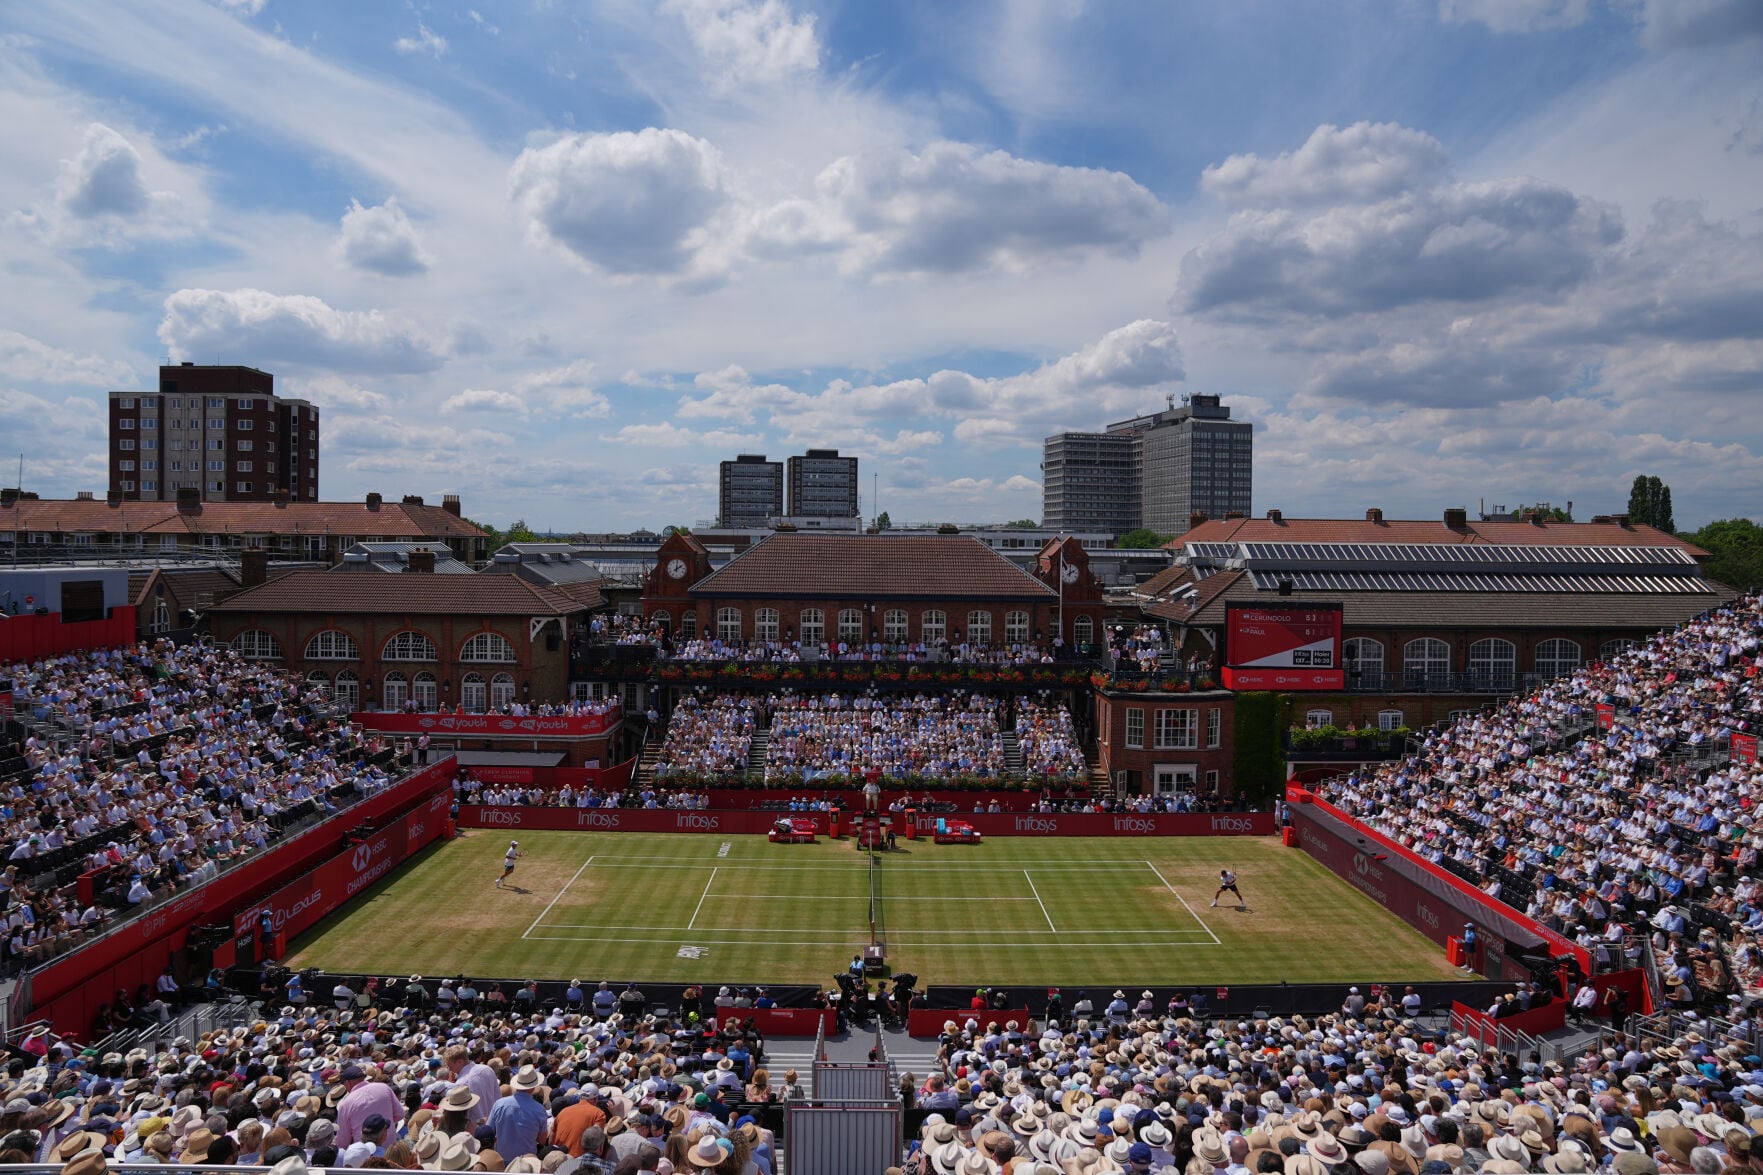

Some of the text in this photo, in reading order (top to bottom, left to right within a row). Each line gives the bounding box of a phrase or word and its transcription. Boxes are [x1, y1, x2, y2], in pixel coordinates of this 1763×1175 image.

[456, 719, 488, 731] youth
[536, 720, 568, 732] youth
[480, 808, 521, 826] Infosys
[578, 810, 620, 828] Infosys
[677, 812, 719, 830] Infosys
[1015, 816, 1057, 833] Infosys
[1114, 816, 1155, 833] Infosys
[1211, 815, 1253, 833] Infosys
[372, 837, 387, 855] HSBC
[347, 856, 392, 895] CHAMPIONSHIPS
[1349, 871, 1387, 904] CHAMPIONSHIPS
[286, 888, 321, 919] LEXUS
[153, 913, 167, 930] PIF
[237, 907, 261, 934] ATP
[1417, 898, 1440, 929] Infosys
[237, 932, 253, 949] Haier
[1476, 926, 1504, 953] ATP 500
[1487, 949, 1501, 964] Haier
